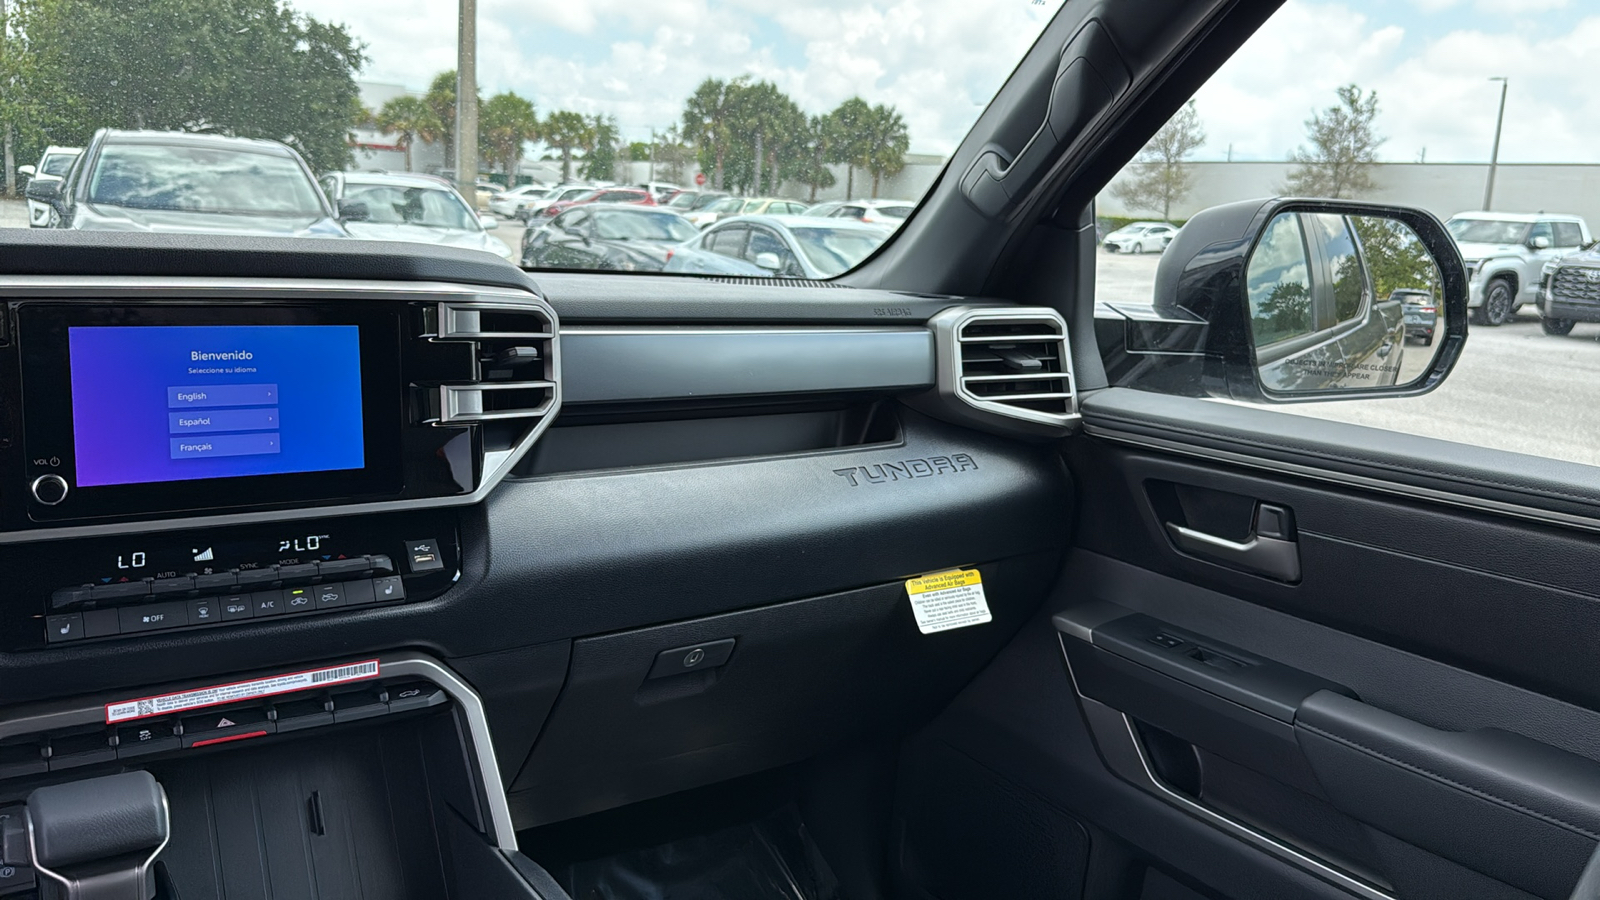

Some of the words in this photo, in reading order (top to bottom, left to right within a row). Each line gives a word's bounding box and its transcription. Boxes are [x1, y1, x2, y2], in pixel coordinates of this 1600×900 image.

[191, 350, 253, 360] Bienvenido
[178, 393, 206, 402] English
[180, 418, 210, 427] Español
[180, 443, 212, 452] Français
[832, 453, 978, 486] TUNDRA
[294, 536, 320, 551] LO
[118, 552, 146, 568] LO
